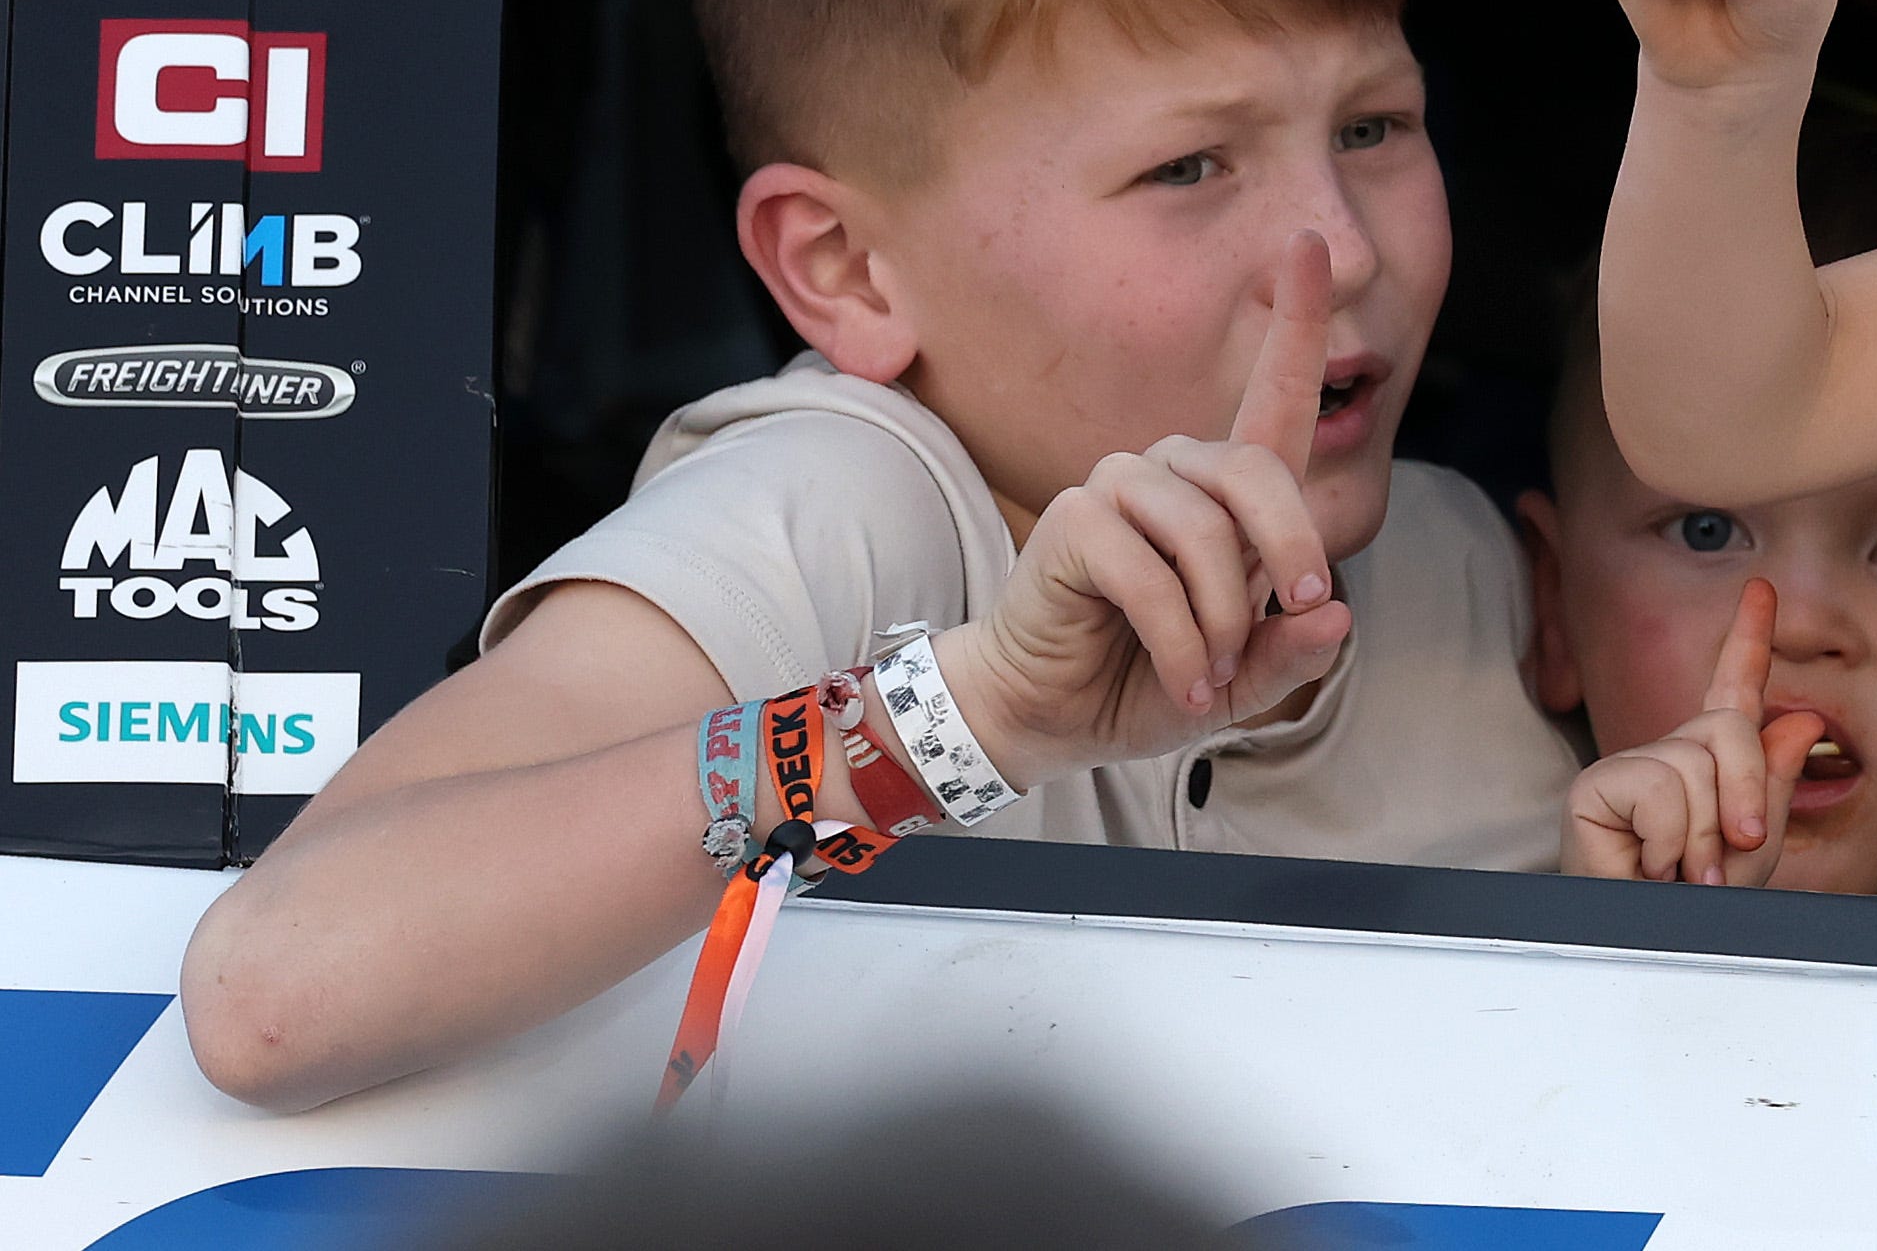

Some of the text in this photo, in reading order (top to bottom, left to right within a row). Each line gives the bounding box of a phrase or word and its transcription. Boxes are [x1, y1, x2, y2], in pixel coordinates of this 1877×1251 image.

[114, 32, 309, 157] CI
[39, 200, 363, 287] CLIMB
[68, 285, 192, 304] CHANNEL
[60, 448, 321, 582] MAC
[59, 576, 321, 632] TOOLS
[771, 702, 815, 820] DECK
